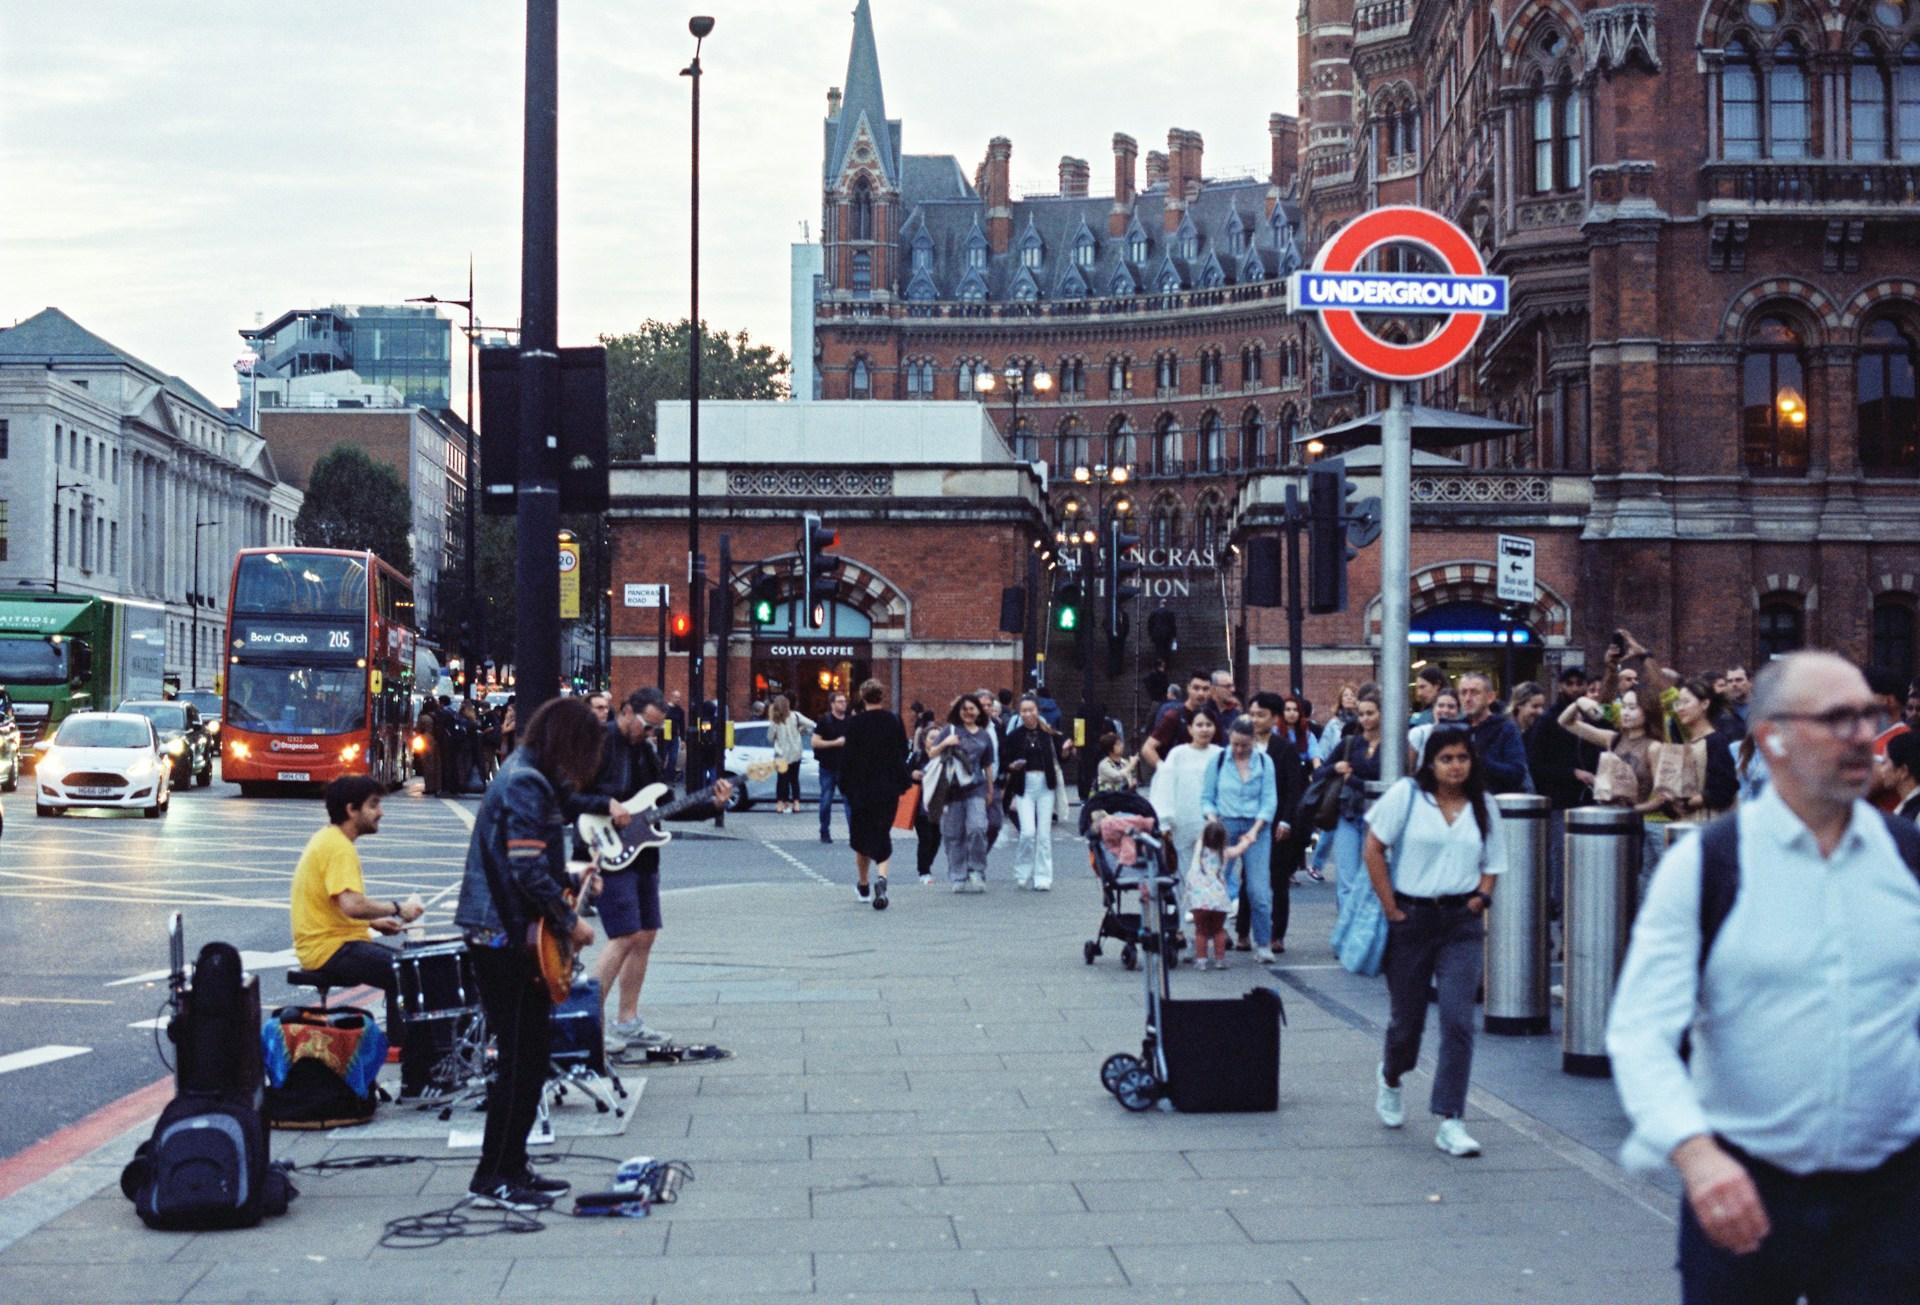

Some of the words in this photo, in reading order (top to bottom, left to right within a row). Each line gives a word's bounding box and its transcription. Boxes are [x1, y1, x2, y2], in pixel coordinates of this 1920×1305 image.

[1309, 279, 1497, 306] UNDERGROUND
[250, 632, 272, 642] Bow
[274, 633, 307, 644] Church
[328, 630, 351, 648] 205
[771, 645, 807, 657] COSTA
[809, 645, 855, 656] COFFEE
[280, 741, 319, 751] Stagecoach
